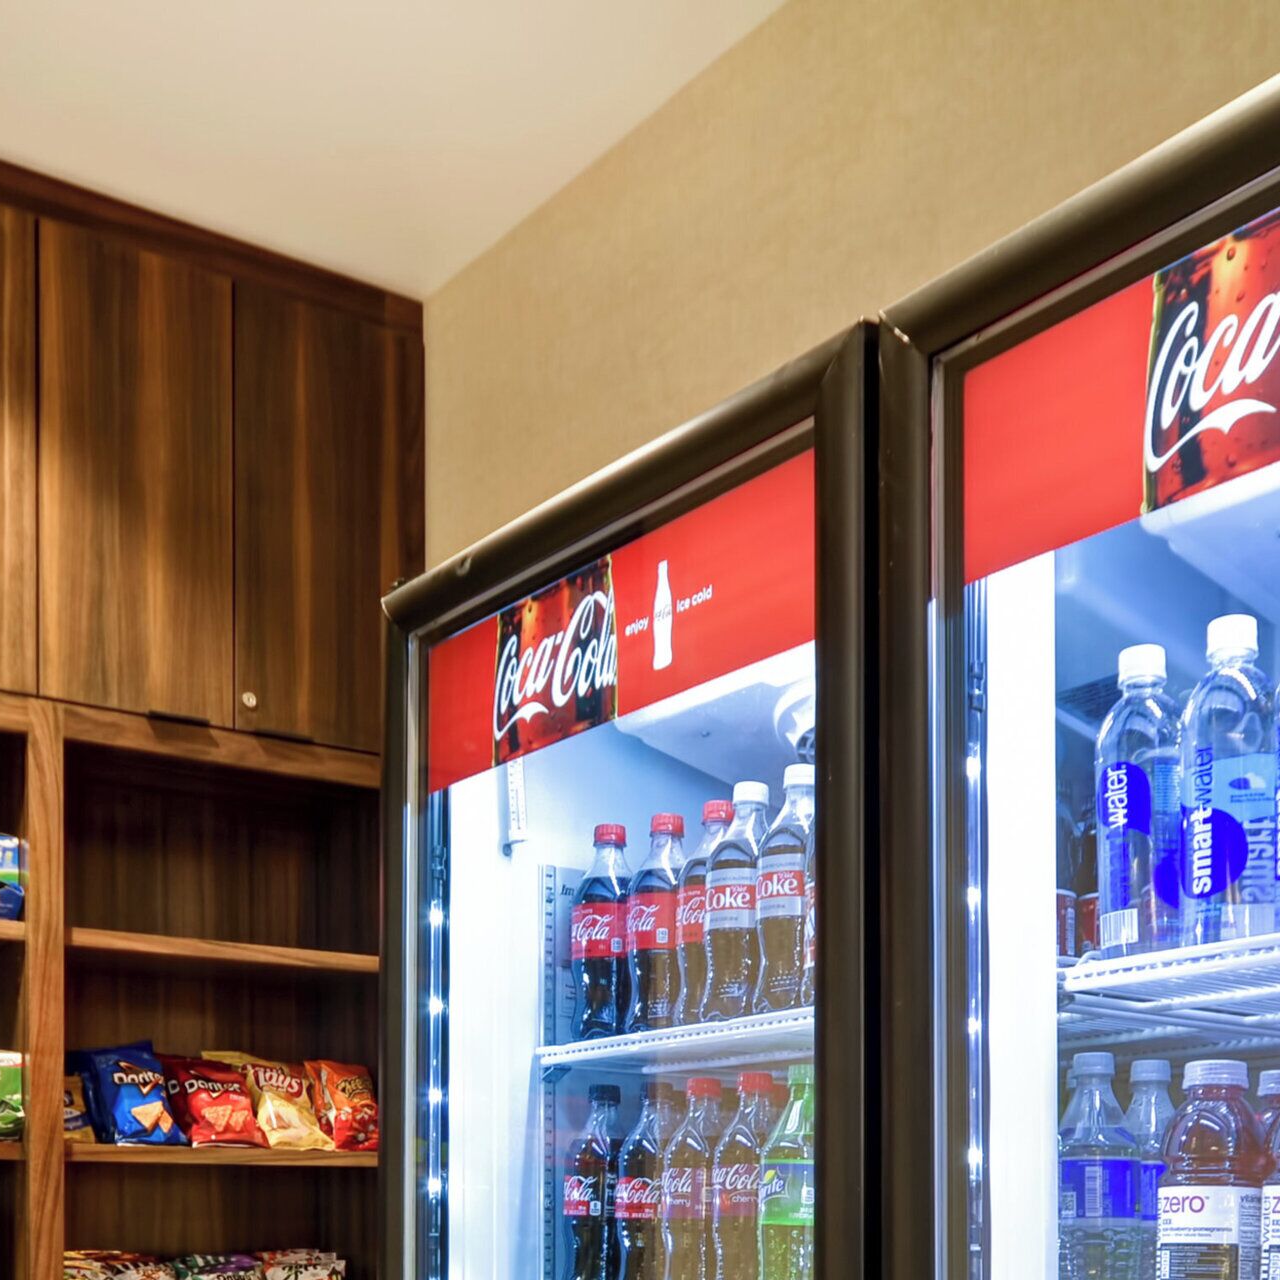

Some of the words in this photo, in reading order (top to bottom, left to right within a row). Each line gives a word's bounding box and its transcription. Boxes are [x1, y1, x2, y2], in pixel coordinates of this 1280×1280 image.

[676, 597, 690, 613] ice
[691, 585, 712, 607] cold
[625, 616, 648, 637] enjoy
[493, 590, 617, 741] Coca-Cola
[706, 884, 750, 909] Coke
[756, 874, 798, 898] Coke
[113, 1072, 164, 1086] Dorito
[336, 1076, 370, 1097] Chee
[1162, 1196, 1205, 1214] zero
